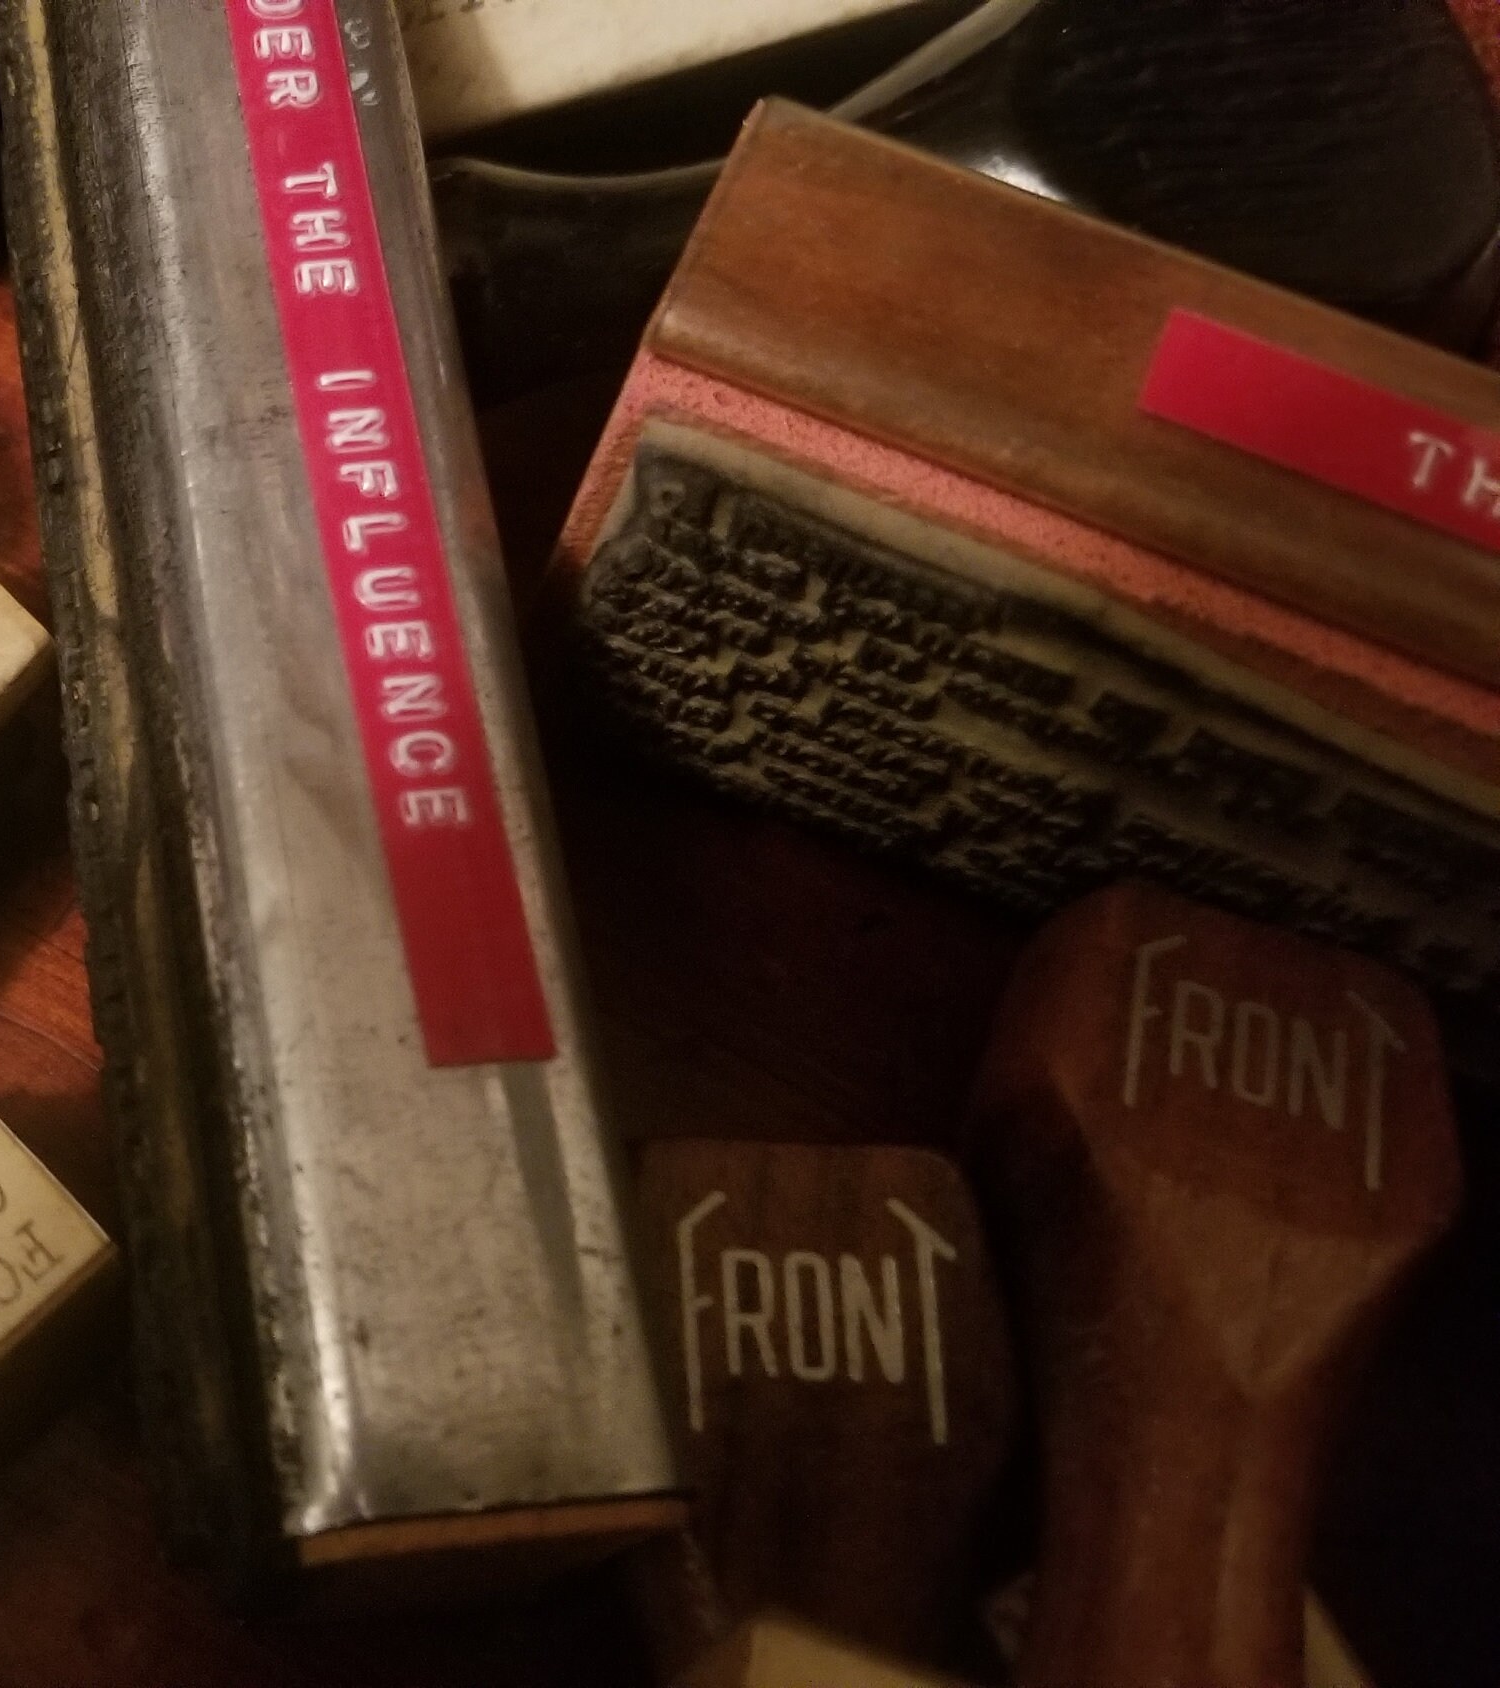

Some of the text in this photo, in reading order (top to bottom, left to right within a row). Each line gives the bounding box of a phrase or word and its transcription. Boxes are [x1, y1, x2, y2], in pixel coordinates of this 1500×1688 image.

[283, 161, 360, 298] THE
[316, 369, 470, 827] INFLUENCE
[1123, 936, 1406, 1191] FRONT
[678, 1191, 956, 1445] FRONT
